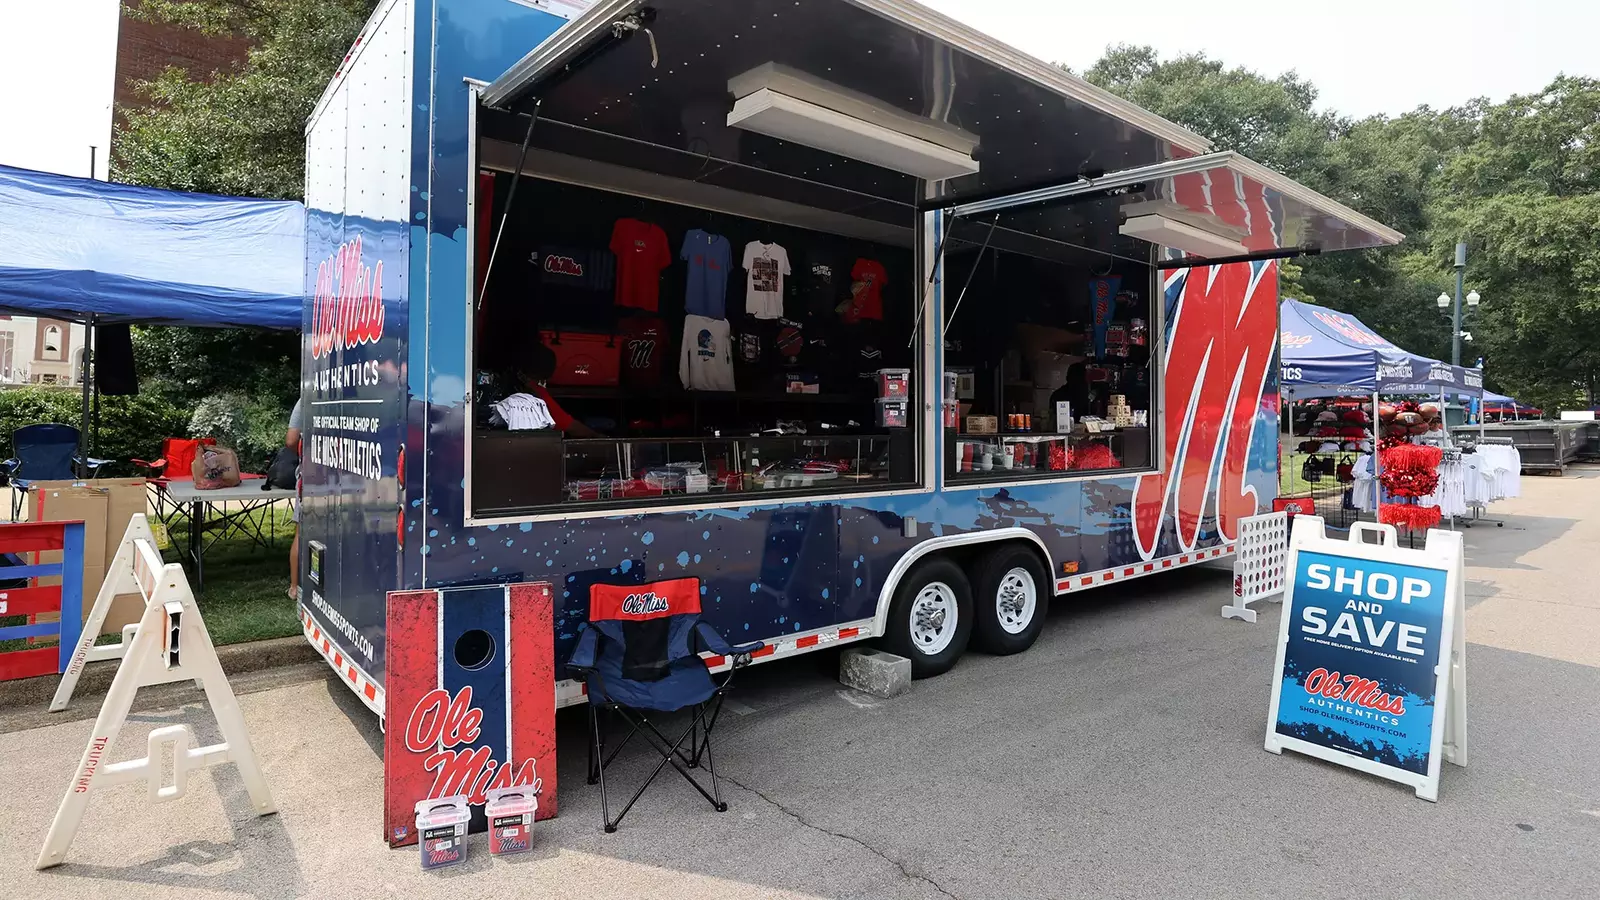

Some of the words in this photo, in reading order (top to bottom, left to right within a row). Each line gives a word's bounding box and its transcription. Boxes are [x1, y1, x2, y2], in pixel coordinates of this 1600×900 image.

[312, 254, 337, 360] Ole
[334, 234, 385, 351] Miss
[313, 359, 379, 392] AUTHENTICS
[313, 416, 321, 428] THE
[321, 416, 340, 429] OFFICIAL
[340, 416, 354, 430] TEAM
[355, 416, 370, 432] SHOP
[371, 418, 380, 433] OF
[311, 434, 321, 464] OLE
[322, 435, 339, 469] MISS
[339, 437, 381, 481] ATHLETICS
[1306, 563, 1432, 604] SHOP
[622, 594, 643, 614] Ole
[641, 592, 668, 613] Miss
[1344, 599, 1383, 615] AND
[1301, 606, 1427, 656] SAVE
[69, 638, 93, 675] TRUCKING
[1331, 641, 1355, 650] DELIVERY
[1354, 646, 1373, 655] OPTION
[1373, 651, 1402, 661] AVAILABLE
[1304, 667, 1344, 699] Ole
[1342, 674, 1406, 716] Miss
[405, 685, 484, 752] Ole
[1299, 705, 1407, 739] SHOP.OLEMISSSPORTS.COM
[1308, 697, 1399, 726] AUTHENTICS
[74, 736, 108, 793] TRUCKING
